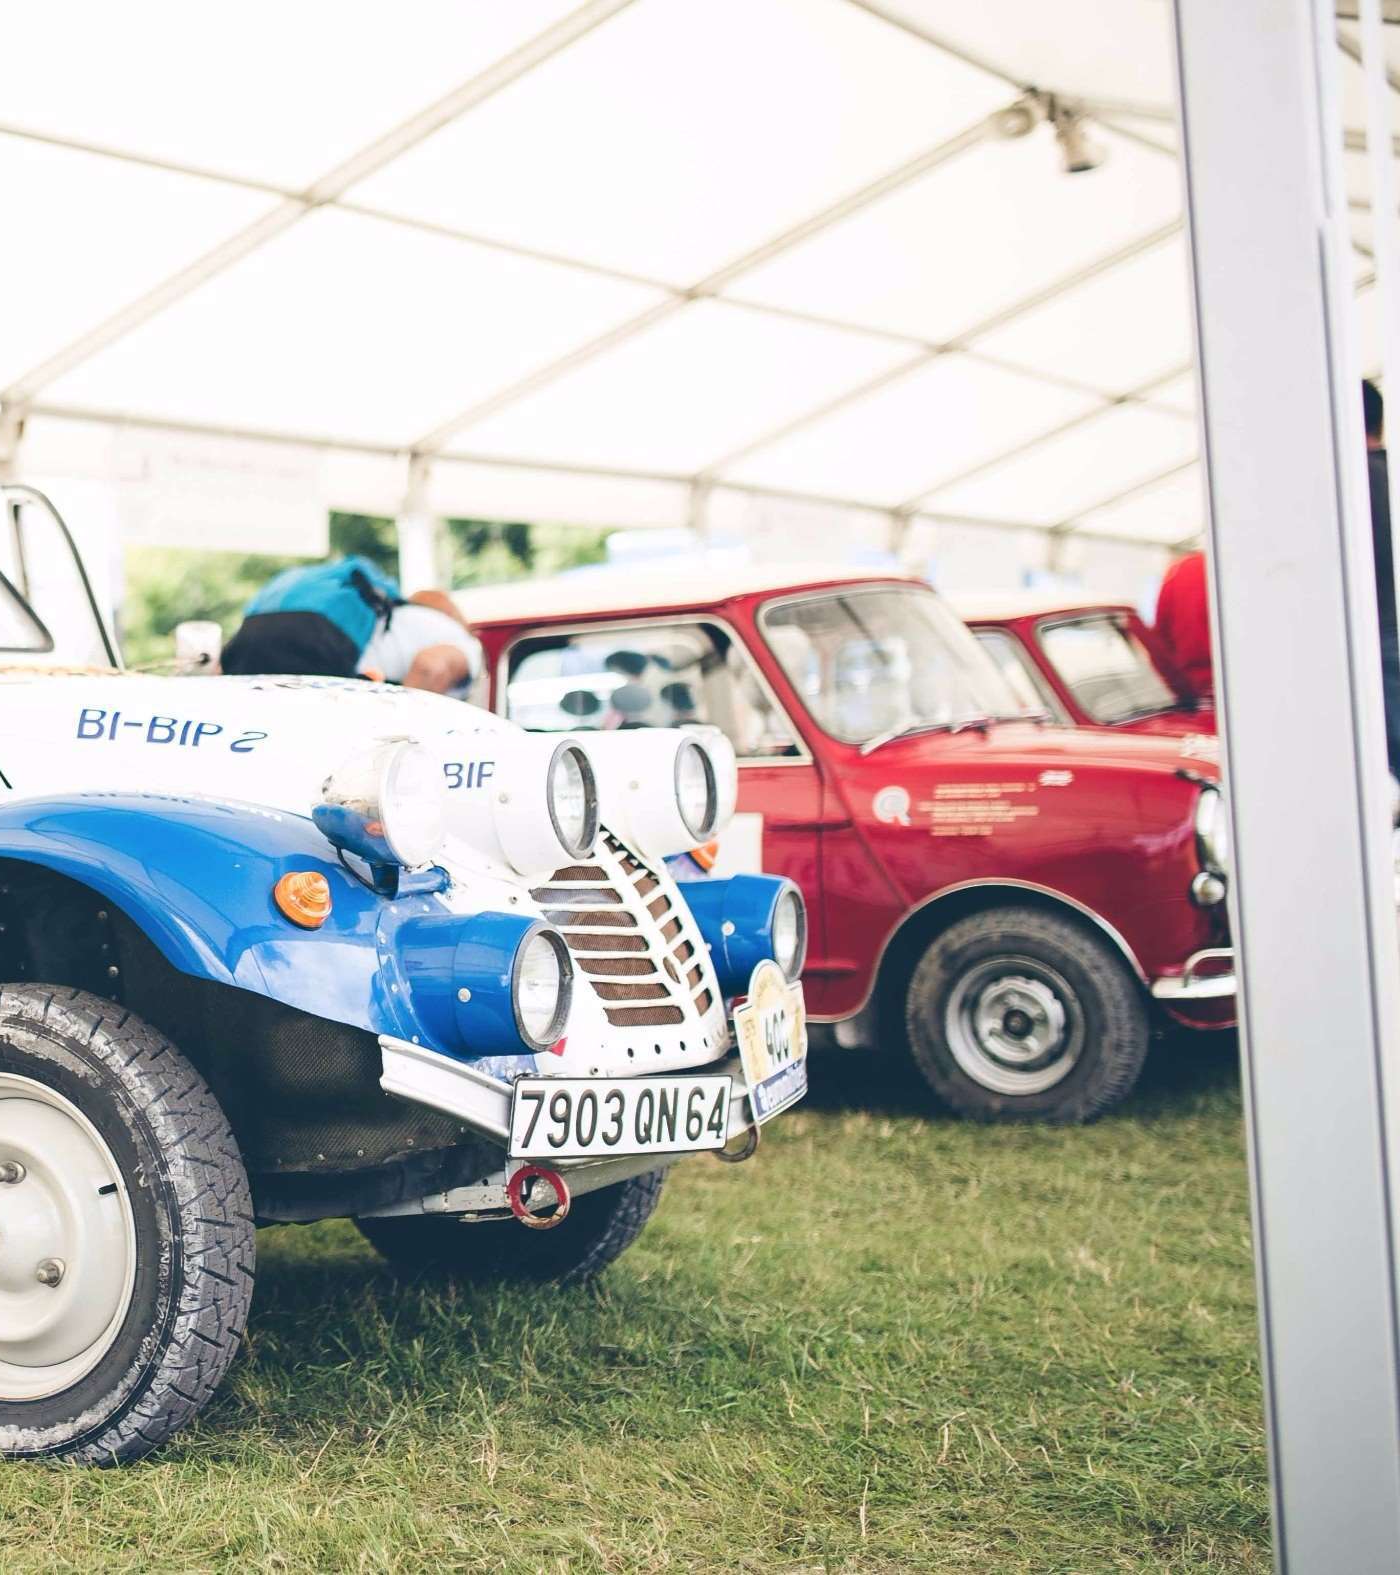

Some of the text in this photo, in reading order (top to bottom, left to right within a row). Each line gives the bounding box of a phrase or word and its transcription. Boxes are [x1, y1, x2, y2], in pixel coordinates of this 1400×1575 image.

[75, 707, 269, 753] BI-BIP 2
[519, 1088, 626, 1150] 7903
[634, 1086, 680, 1146] QN
[685, 1085, 727, 1143] 64
